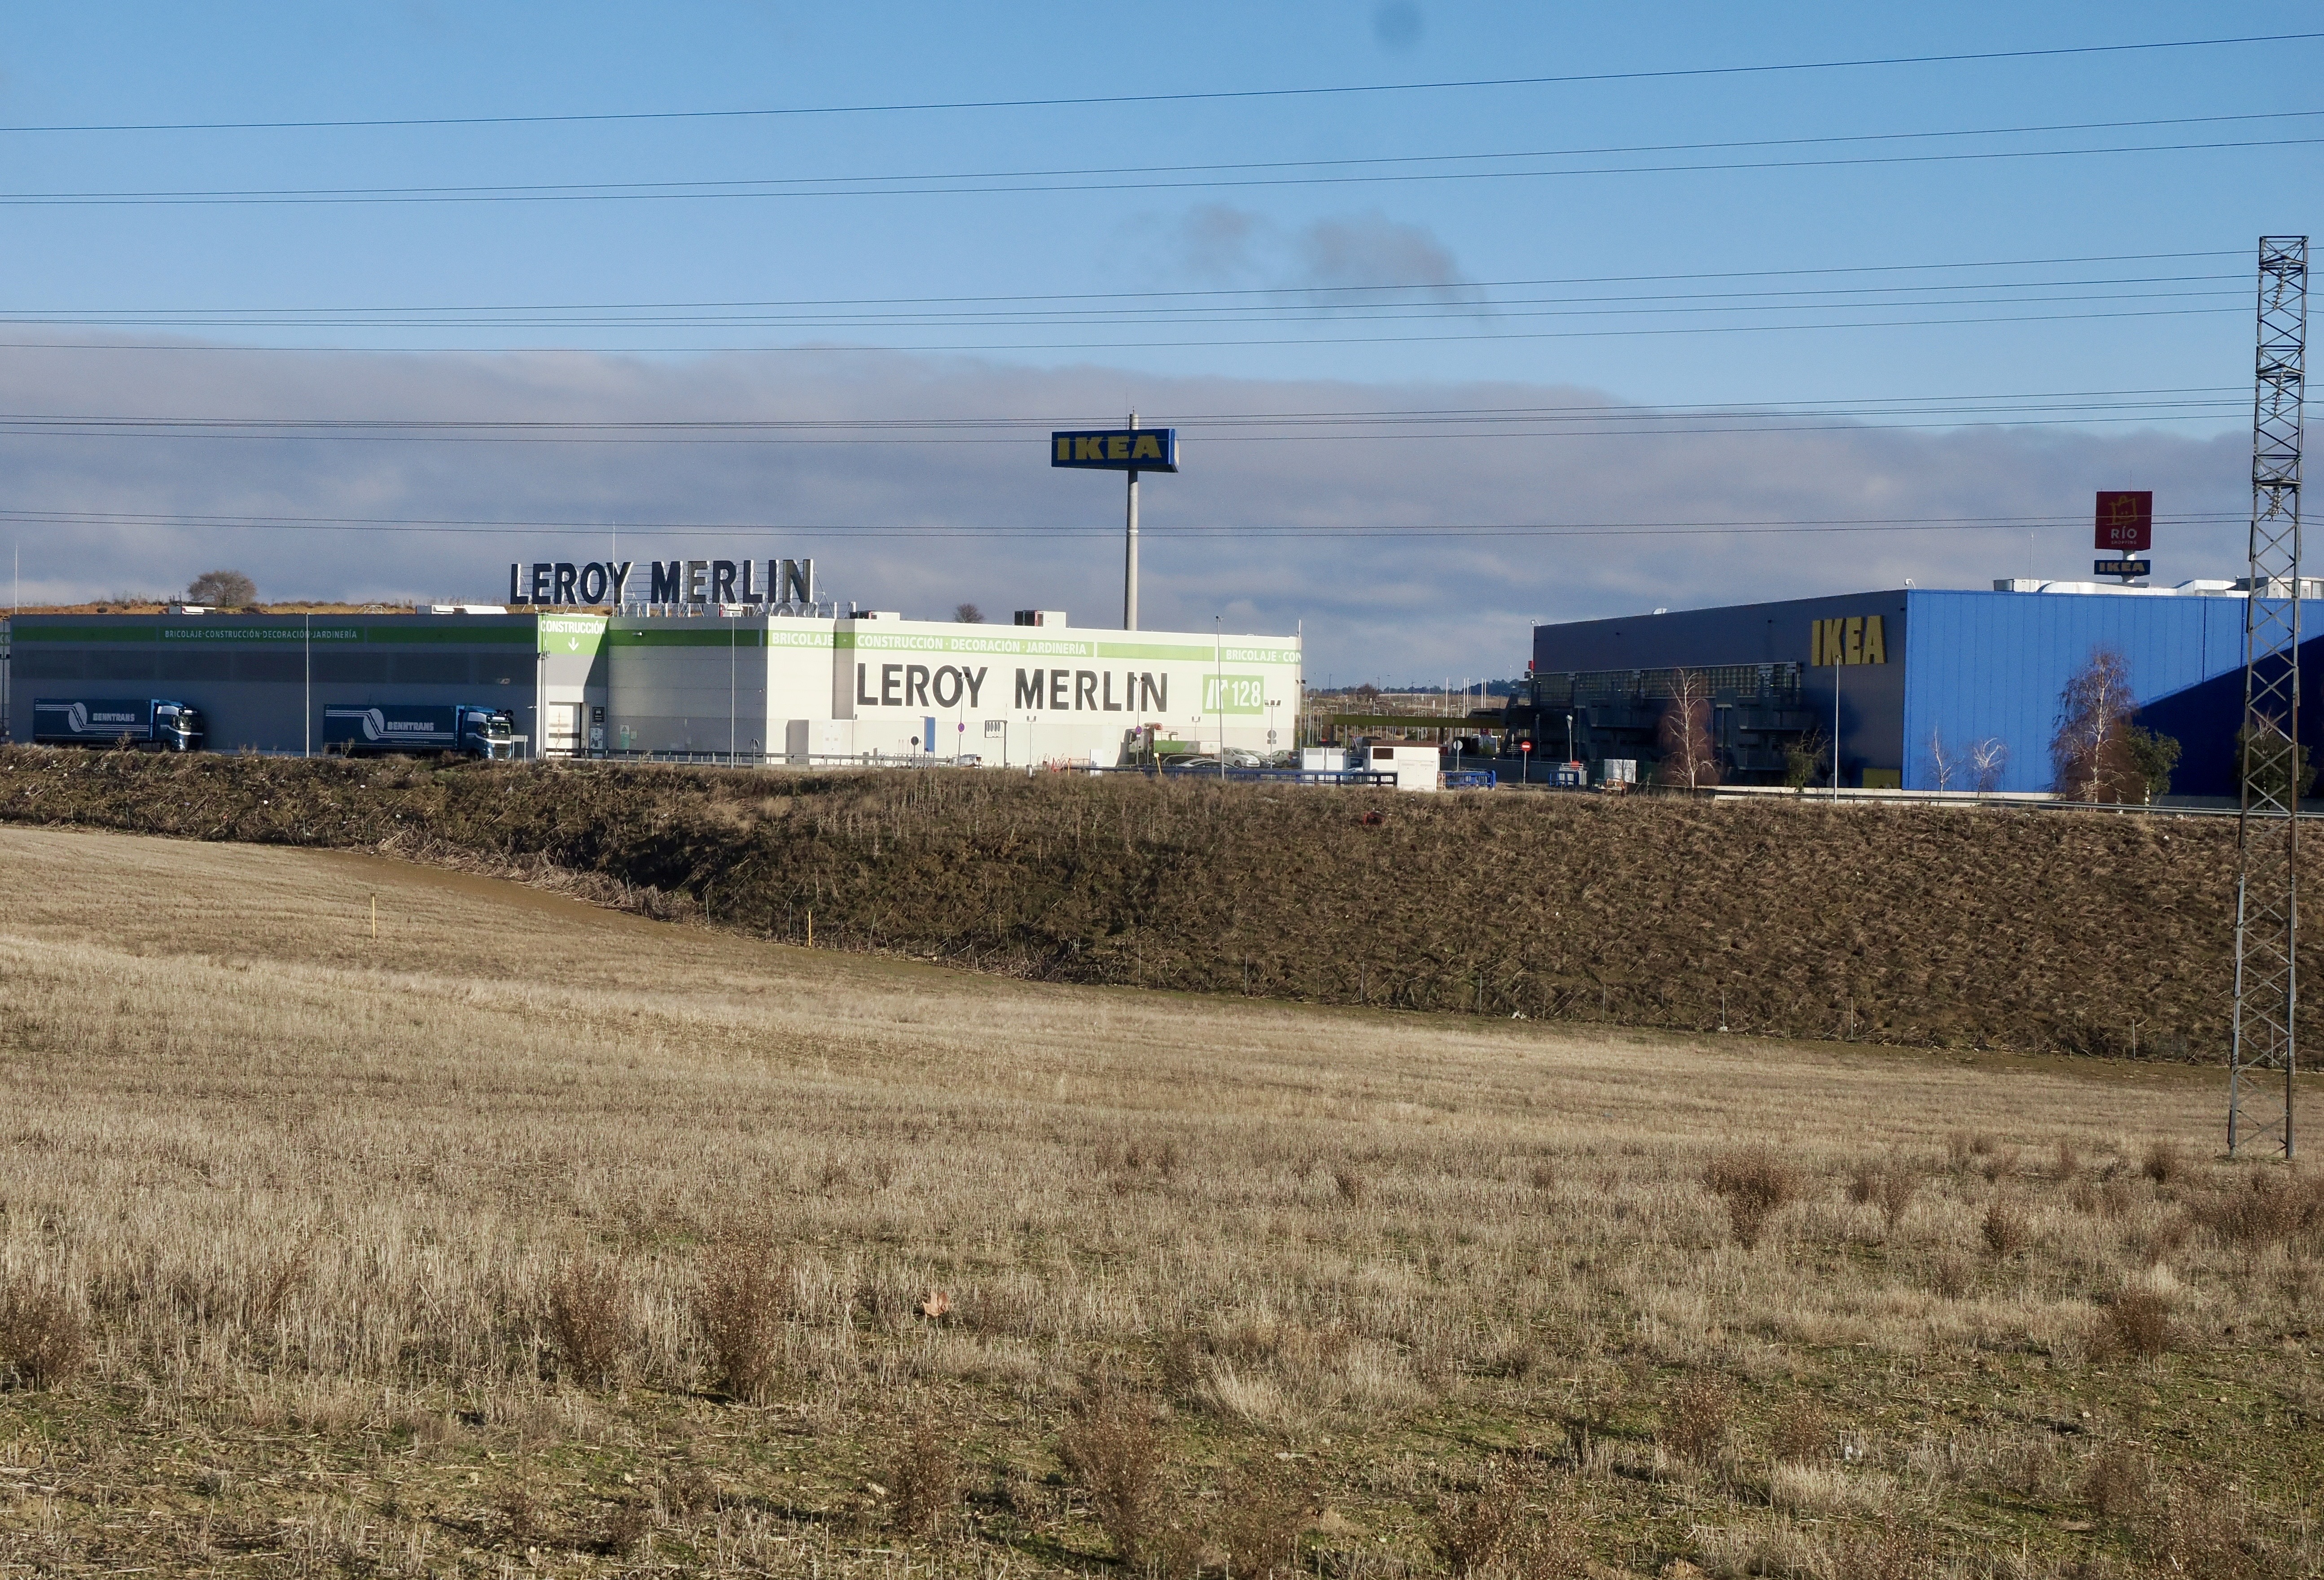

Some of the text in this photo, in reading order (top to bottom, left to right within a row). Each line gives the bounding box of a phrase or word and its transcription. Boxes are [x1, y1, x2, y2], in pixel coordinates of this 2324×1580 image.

[1057, 435, 1162, 460] IKEA
[2111, 526, 2137, 539] RÍO
[2099, 562, 2145, 572] IKEA
[510, 559, 813, 605] LEROY MERLIN
[205, 629, 260, 638] CONSTRUCCIÓN
[263, 629, 310, 638] DECORACIÓN
[313, 629, 357, 638] JARDINERÍA
[540, 620, 606, 635] CONSTRUCCIÓN
[772, 632, 1087, 655] BRICOLAJE CONSTRUCCIÓN DECORACIÓN JARDINERÍA
[1811, 615, 1886, 666] IKEA
[1226, 650, 1277, 662] BRICOLAJE
[857, 663, 1167, 712] LEROY MERLIN
[1232, 680, 1261, 707] 128
